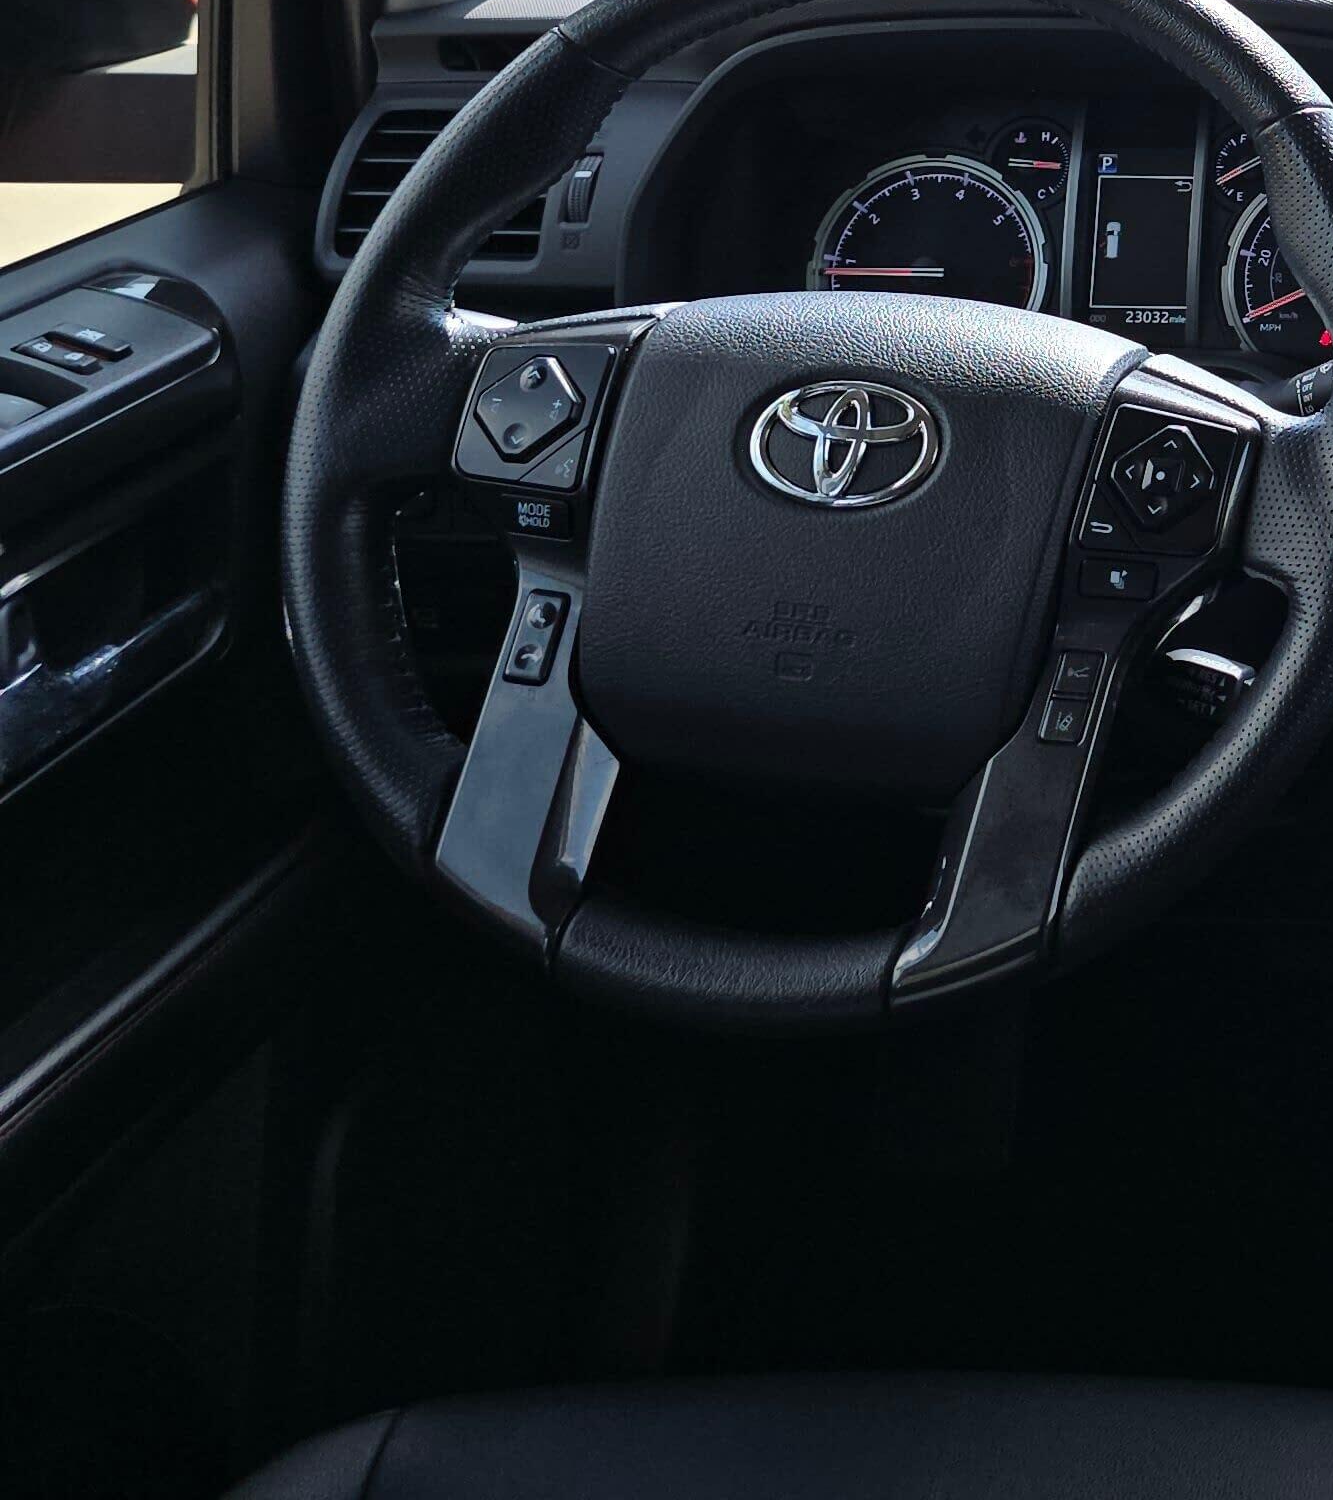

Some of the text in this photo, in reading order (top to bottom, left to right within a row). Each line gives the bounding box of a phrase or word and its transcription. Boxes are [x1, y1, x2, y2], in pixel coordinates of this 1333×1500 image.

[1041, 131, 1051, 142] H
[1239, 133, 1249, 145] F
[1102, 156, 1113, 172] P
[911, 188, 921, 200] 3
[954, 188, 966, 201] 4
[1037, 188, 1047, 199] C
[1236, 191, 1245, 202] E
[868, 213, 881, 226] 2
[992, 215, 1005, 227] 5
[1257, 249, 1272, 267] 20
[1125, 311, 1169, 324] 23032
[1259, 323, 1282, 333] MPH
[518, 501, 551, 517] MODE
[525, 516, 551, 528] HOLD
